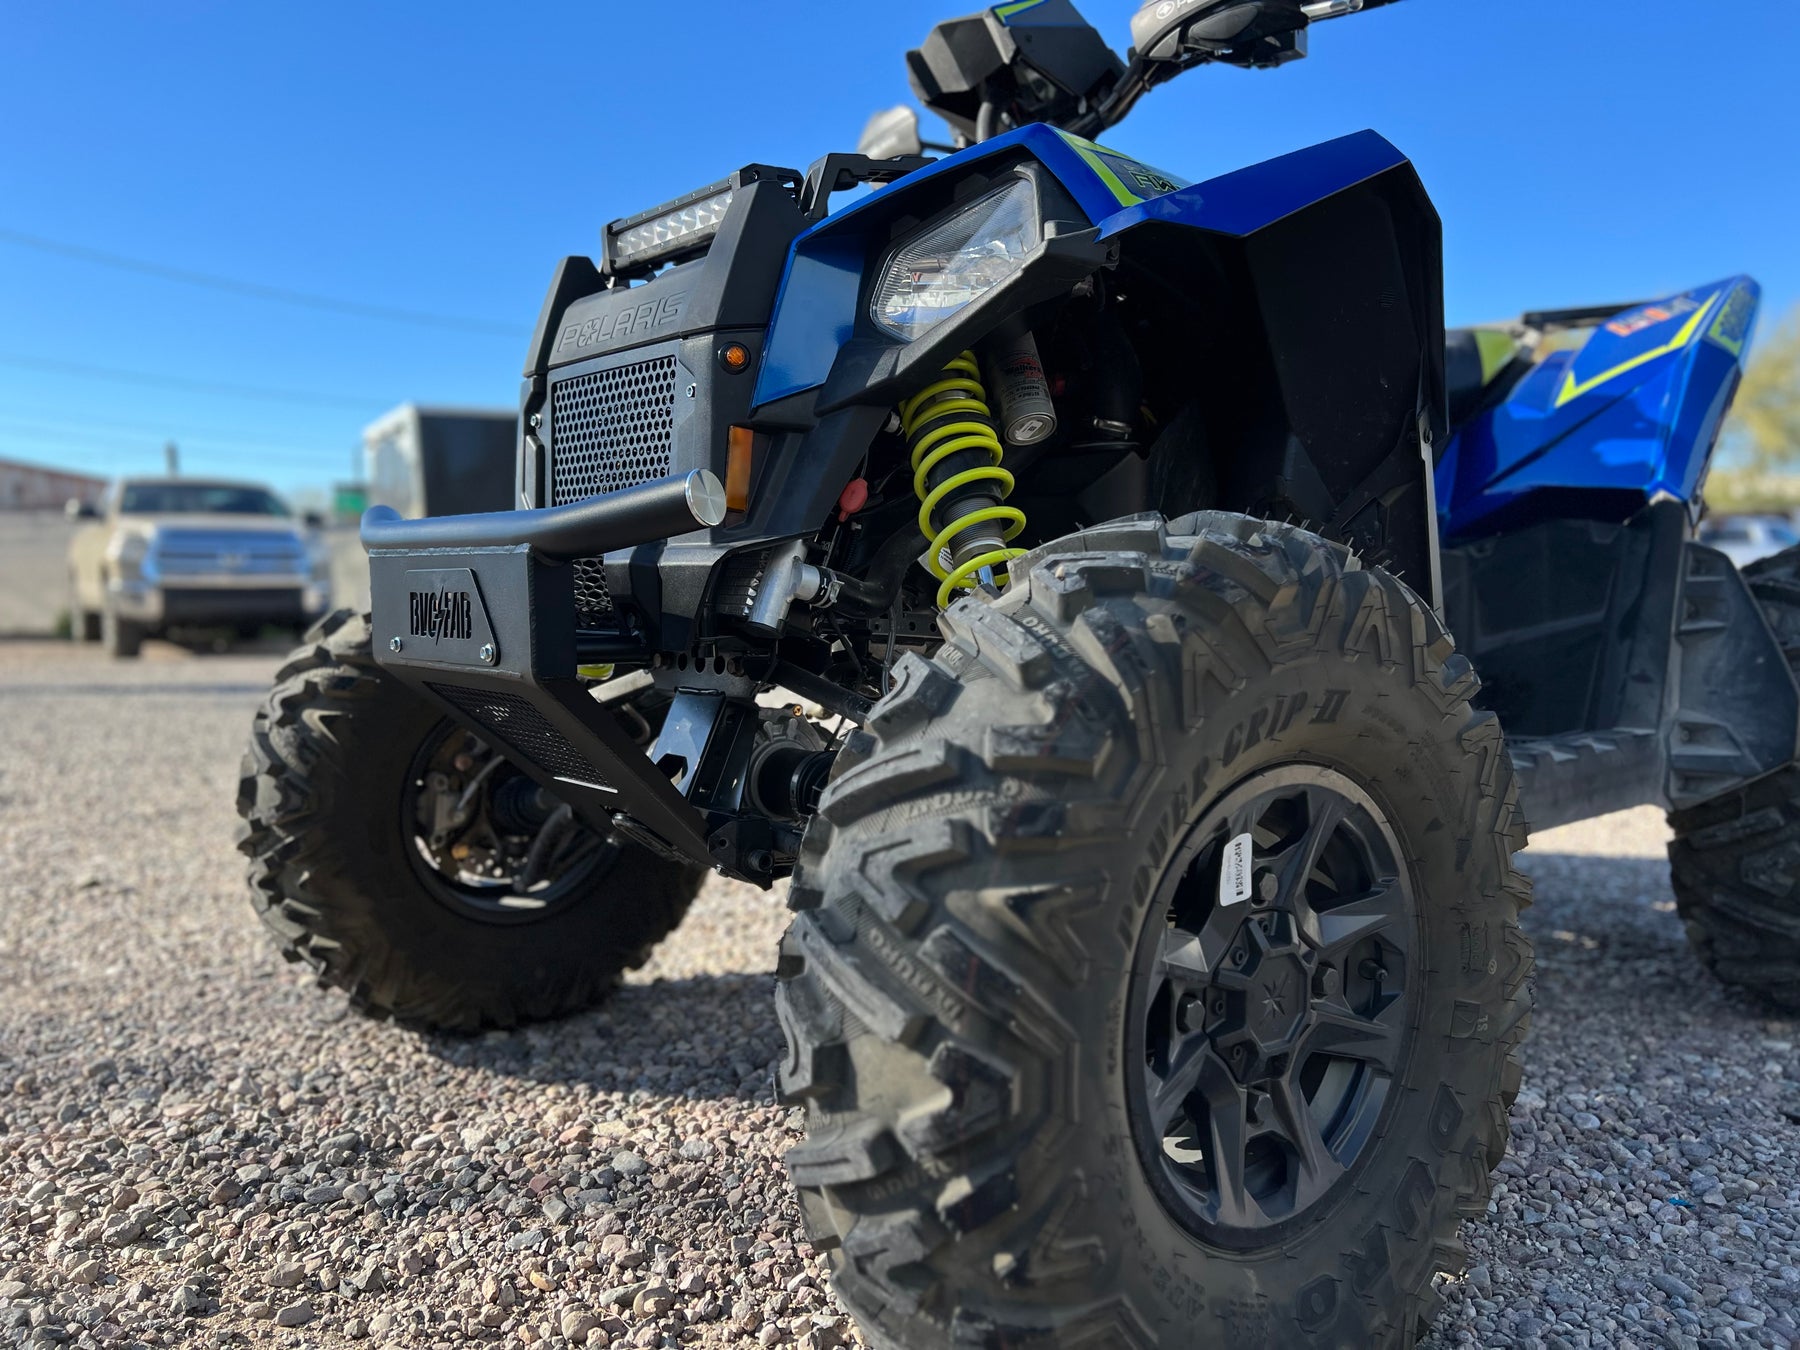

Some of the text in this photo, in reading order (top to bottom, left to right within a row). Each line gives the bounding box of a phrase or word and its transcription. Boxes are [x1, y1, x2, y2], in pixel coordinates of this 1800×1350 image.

[557, 291, 687, 352] POLARIS
[1222, 692, 1308, 767] GRIP
[1309, 689, 1351, 724] II
